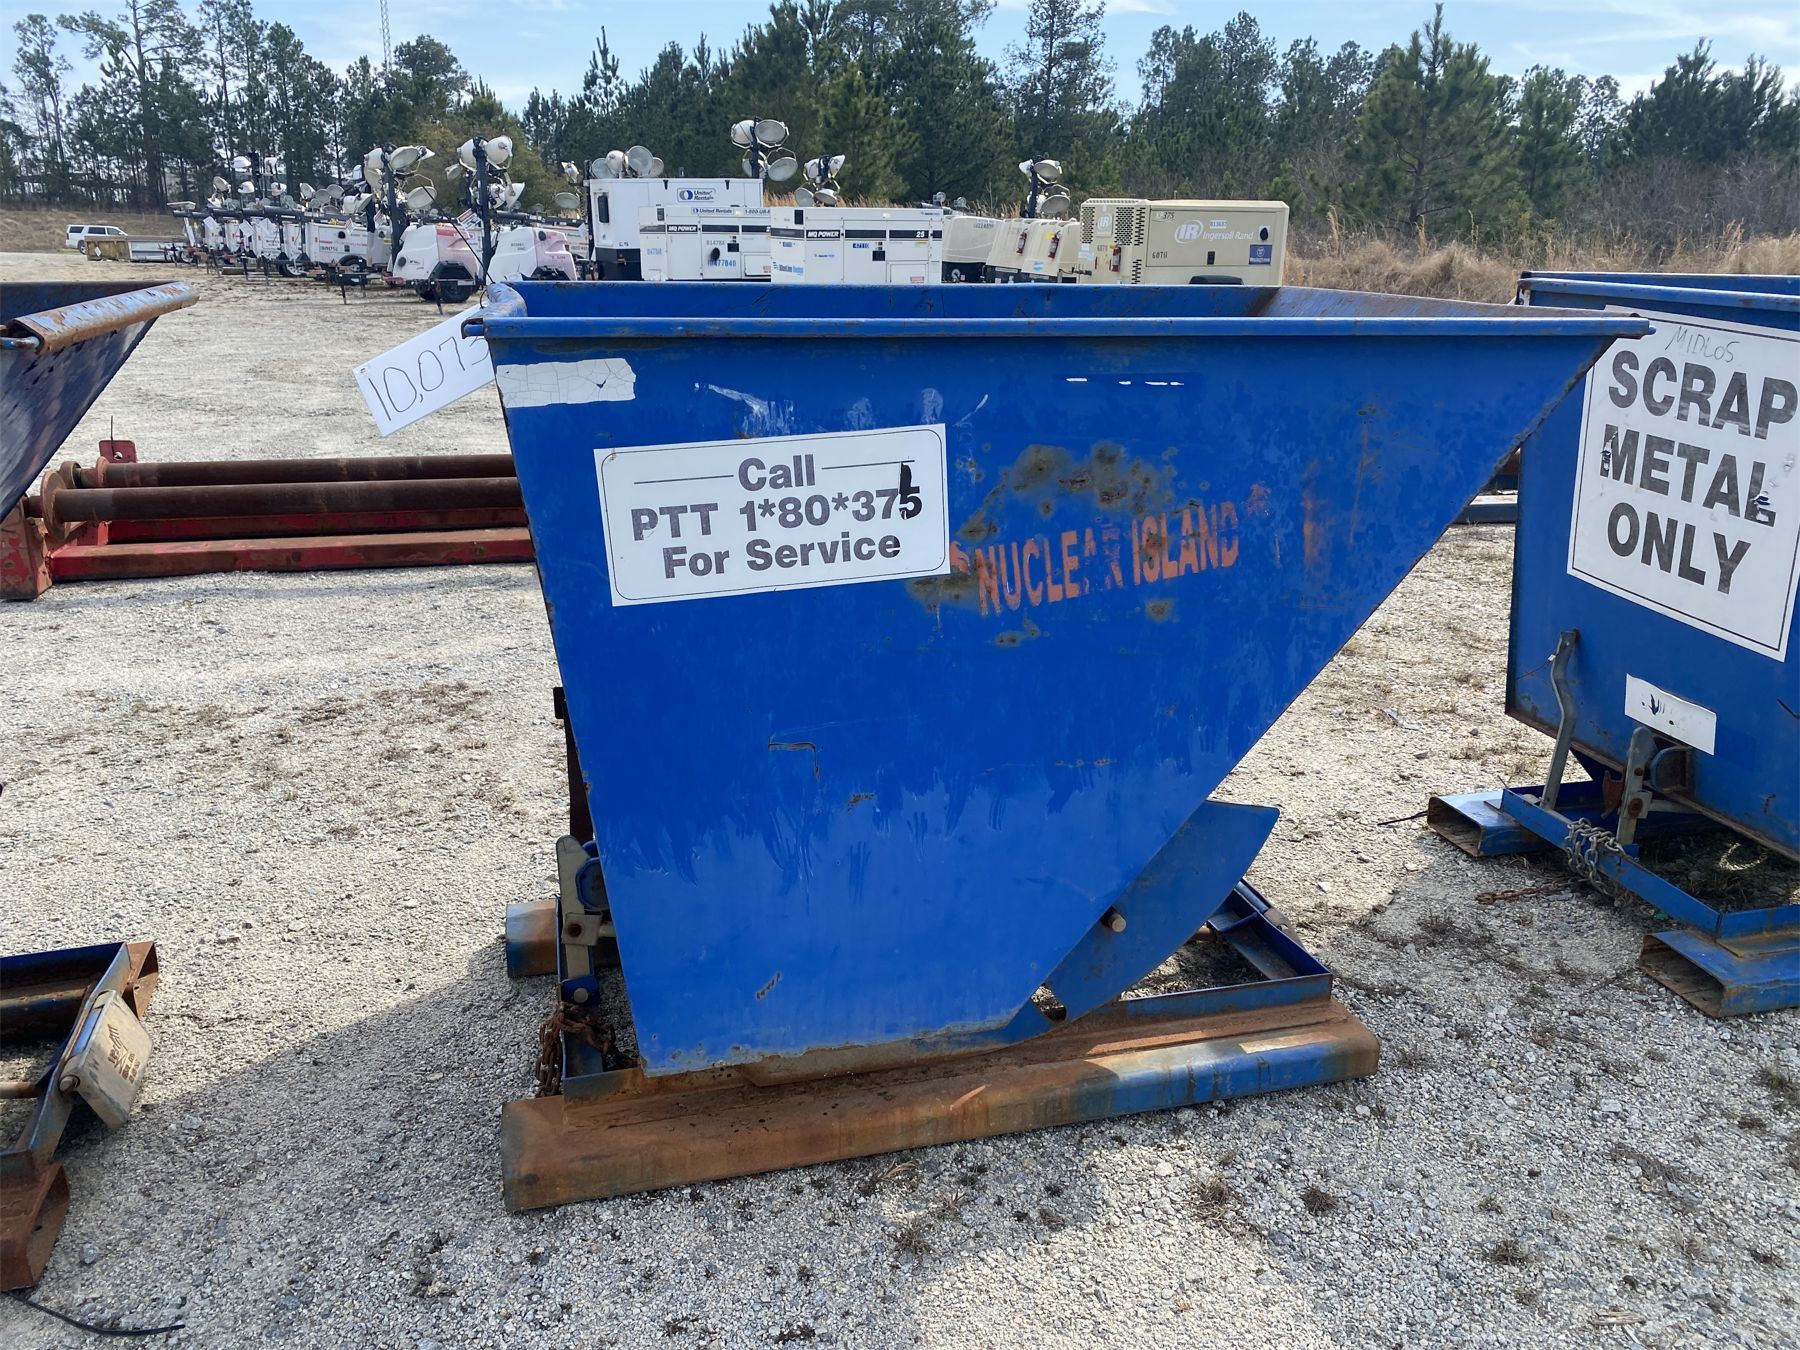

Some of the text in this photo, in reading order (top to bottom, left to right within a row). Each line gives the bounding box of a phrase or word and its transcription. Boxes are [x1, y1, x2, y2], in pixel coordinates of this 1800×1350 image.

[1203, 231, 1254, 241] Ingersoll Rand
[1608, 349, 1798, 440] SCRAP
[738, 453, 816, 491] Call
[1600, 423, 1776, 528] METAL
[631, 502, 718, 541] PTT
[662, 531, 901, 579] For Service
[1131, 500, 1240, 586] ISLAND
[1607, 502, 1751, 595] ONLY
